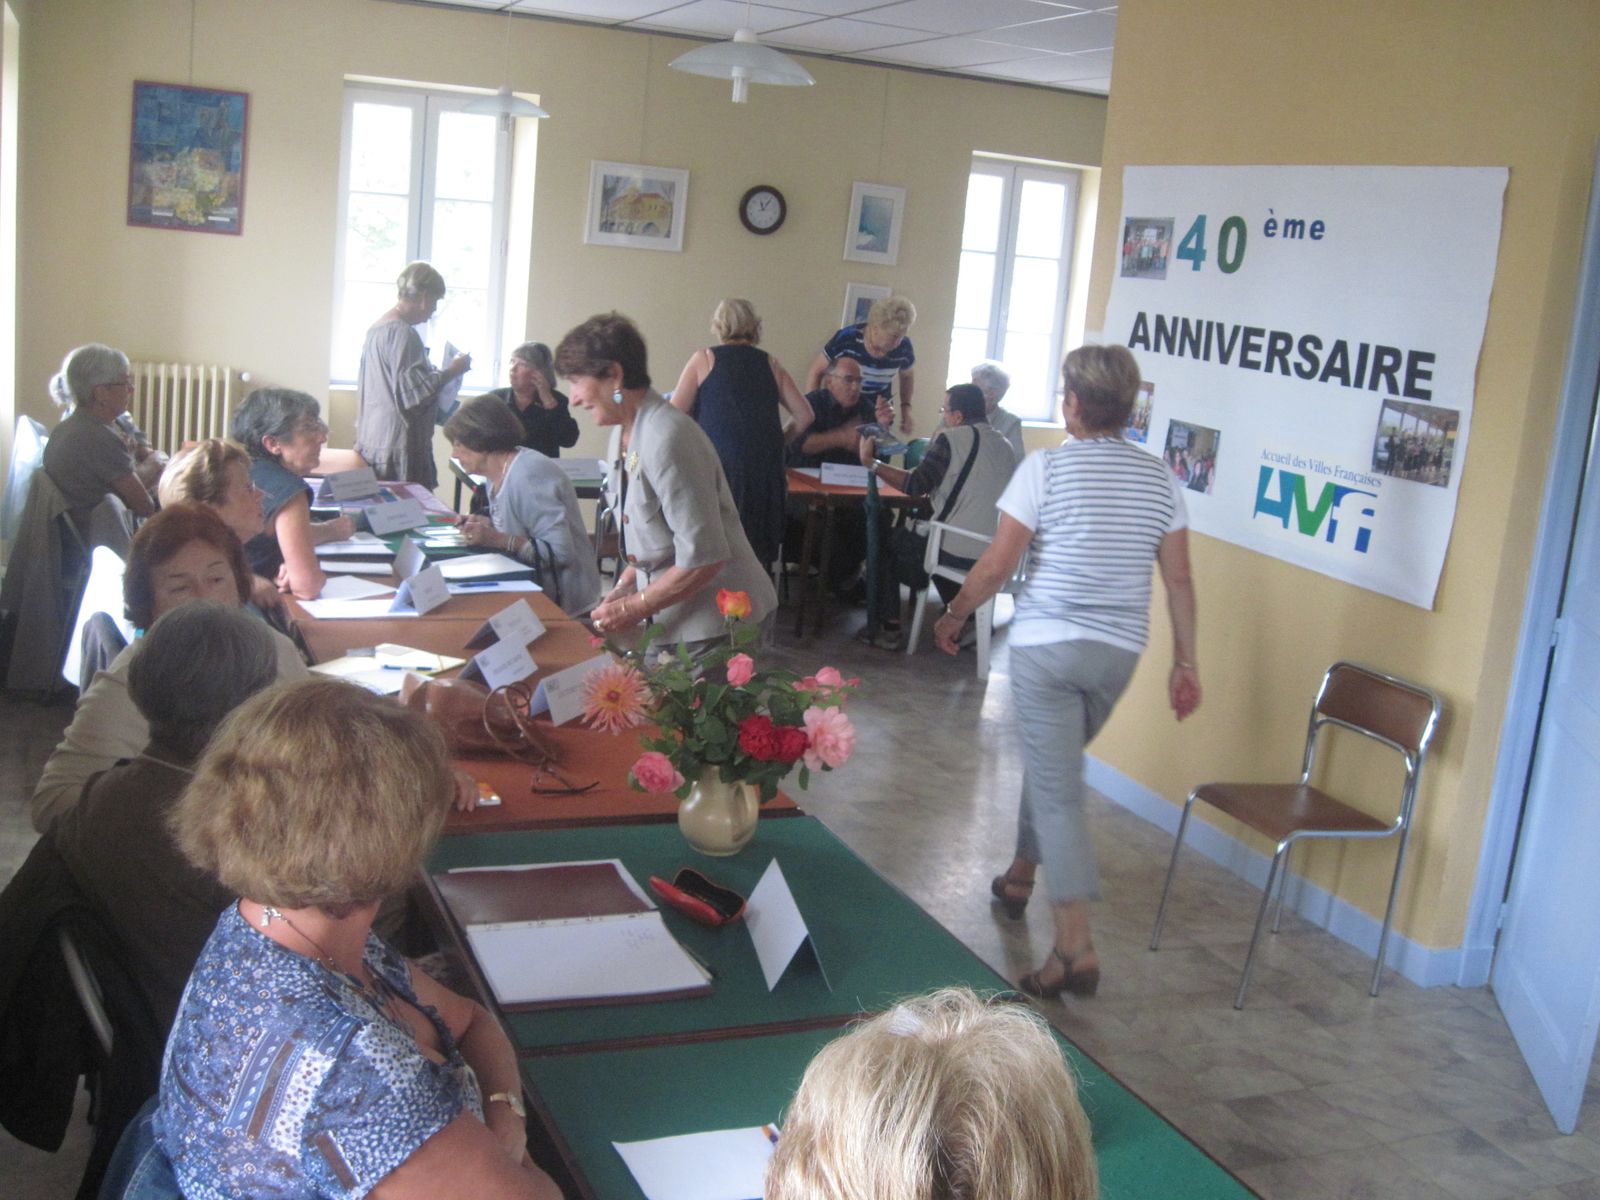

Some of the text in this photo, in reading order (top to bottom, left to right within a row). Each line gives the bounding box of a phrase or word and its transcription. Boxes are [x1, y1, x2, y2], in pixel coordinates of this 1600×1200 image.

[1177, 208, 1326, 274] 40 ème
[1128, 311, 1436, 401] ANNIVERSAIRE
[1261, 448, 1382, 487] Accueil des Villes Françaises
